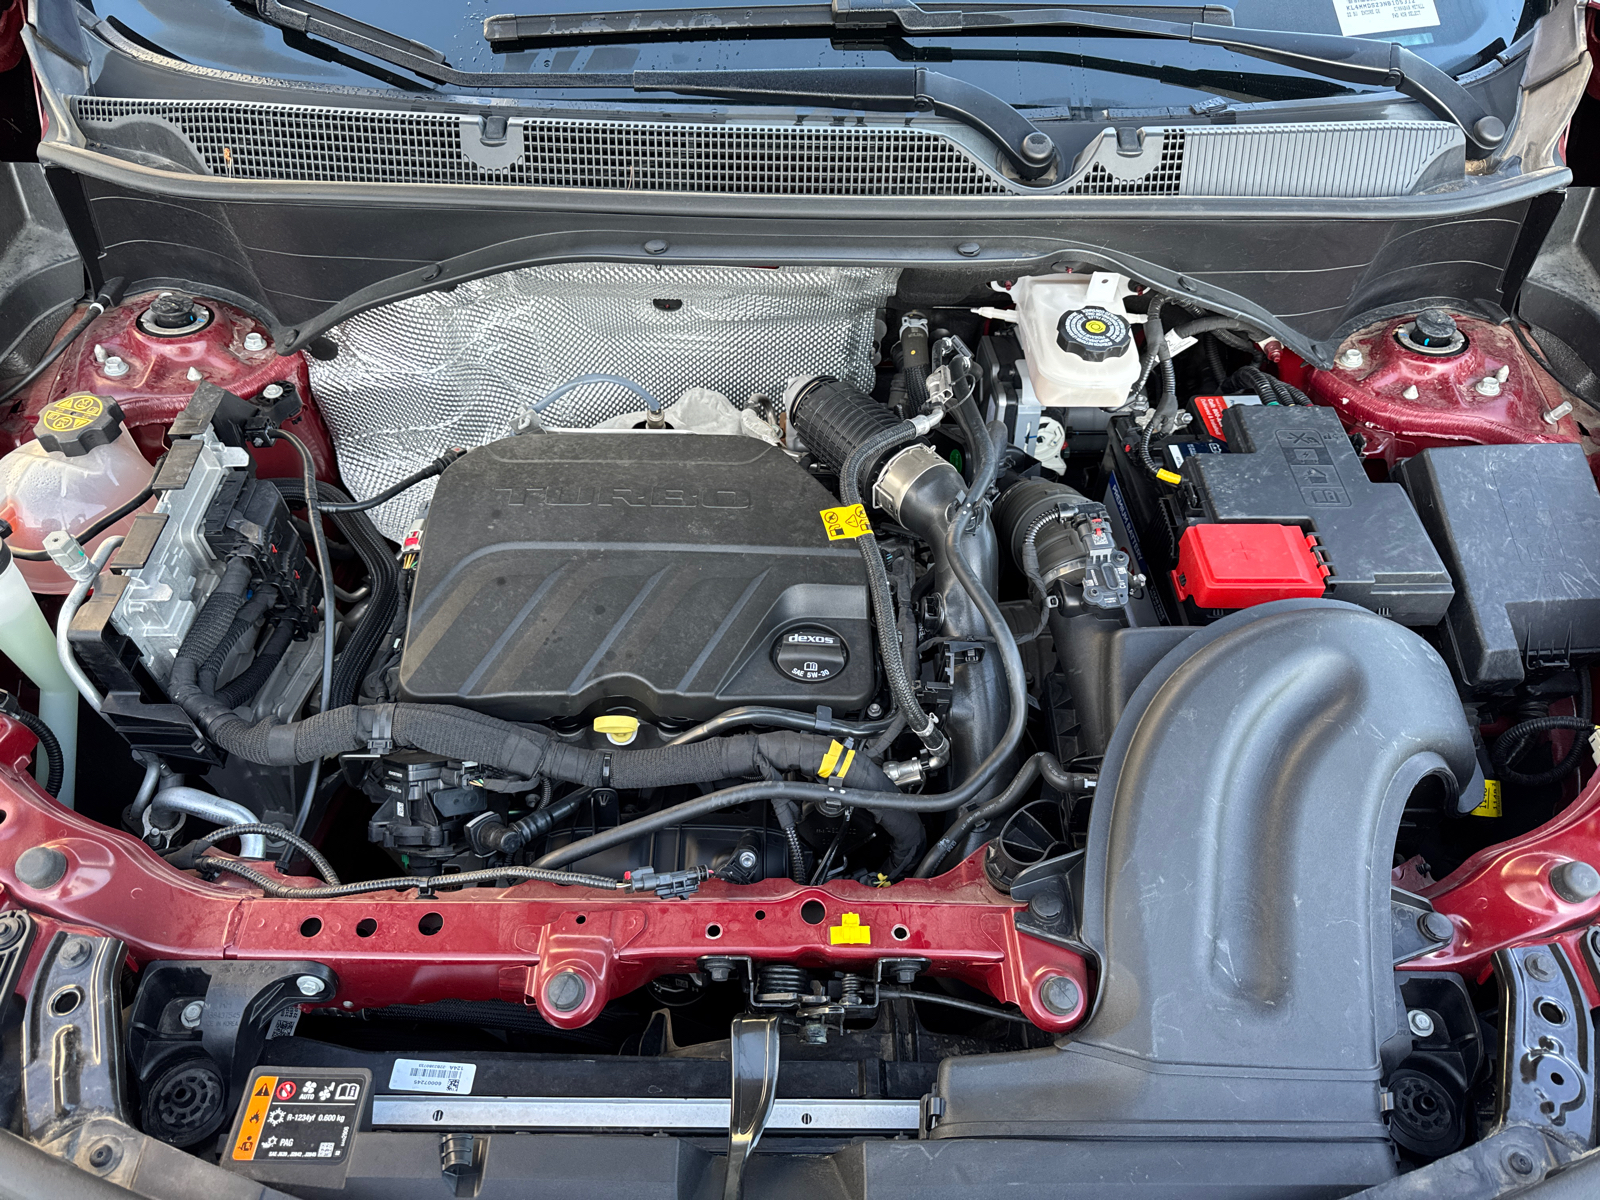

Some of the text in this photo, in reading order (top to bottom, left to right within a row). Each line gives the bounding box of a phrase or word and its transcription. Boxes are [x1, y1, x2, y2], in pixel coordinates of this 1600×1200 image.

[493, 486, 750, 509] TURBO
[1112, 484, 1142, 560] PREMIUM BATTERY
[788, 633, 835, 644] dexos
[791, 667, 830, 678] SAE 5W-30
[286, 1113, 346, 1123] R-1234yf 0.600 kg
[279, 1138, 294, 1147] PAG
